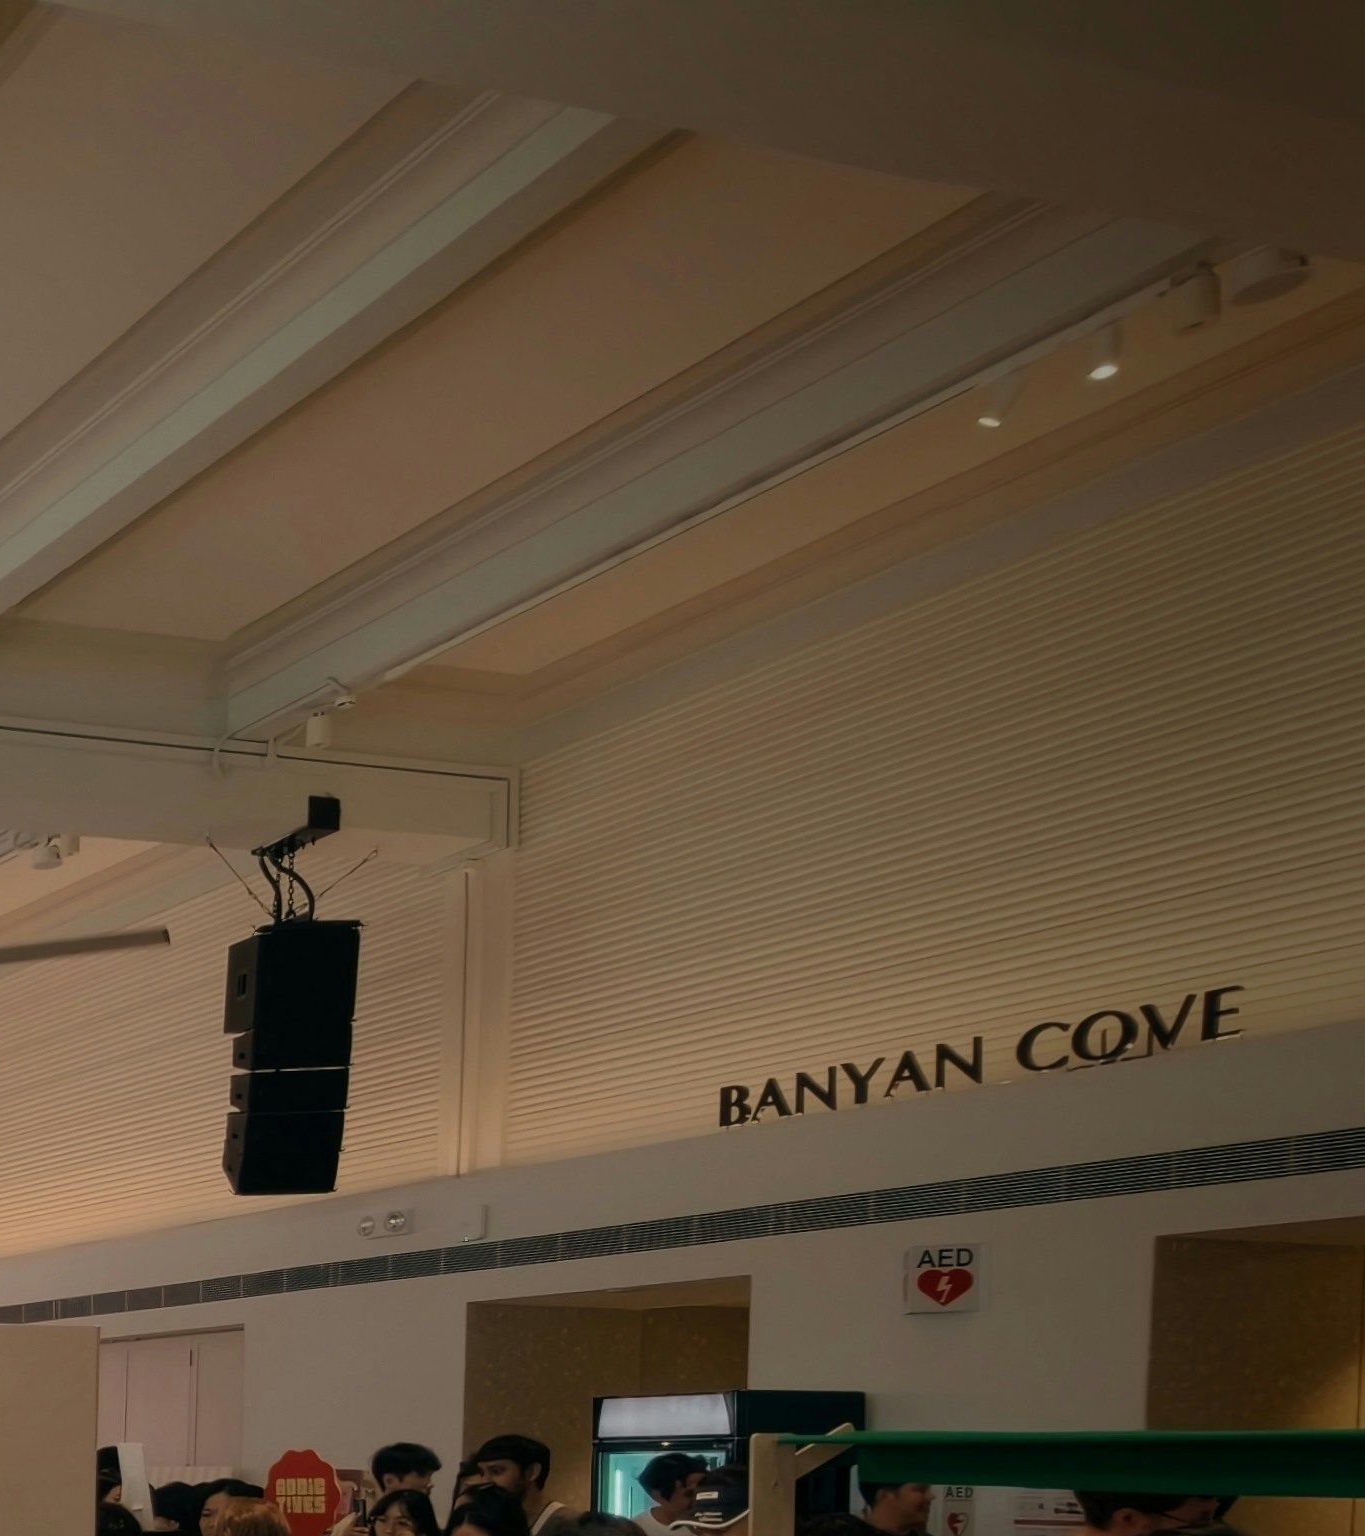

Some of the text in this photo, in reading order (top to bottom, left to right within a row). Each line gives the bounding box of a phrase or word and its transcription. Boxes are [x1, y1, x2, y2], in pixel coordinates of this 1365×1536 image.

[718, 985, 1245, 1128] BANYAN COVE
[916, 1248, 974, 1268] AED
[945, 1486, 973, 1499] AED
